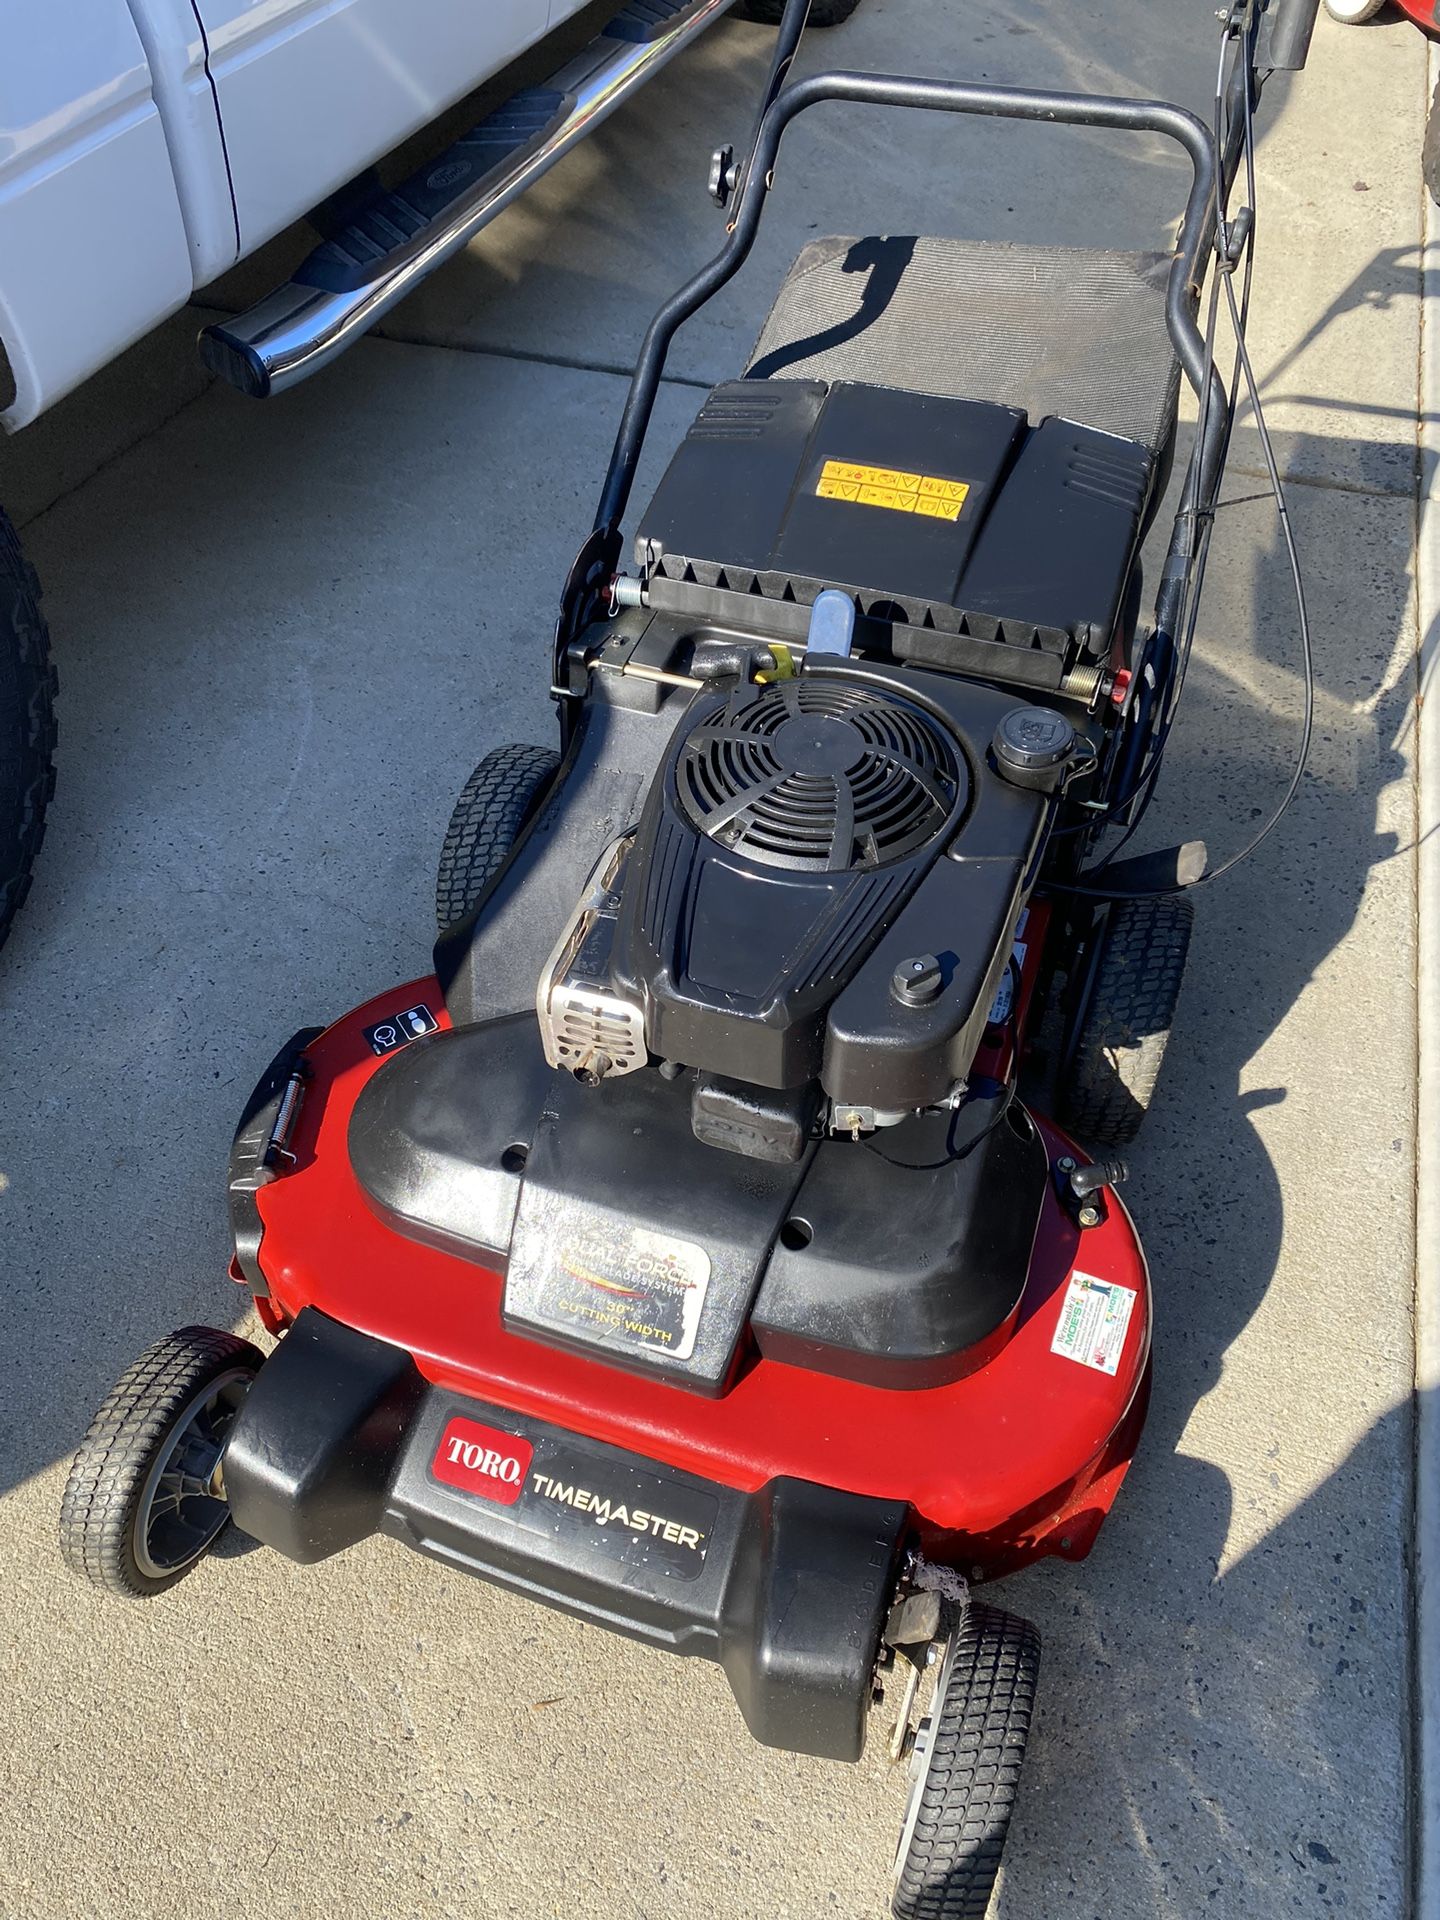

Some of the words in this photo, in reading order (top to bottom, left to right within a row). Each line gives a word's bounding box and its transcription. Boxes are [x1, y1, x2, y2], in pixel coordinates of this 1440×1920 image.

[624, 1254, 692, 1286] FORCE
[639, 1276, 684, 1297] SYSTEM
[558, 1299, 621, 1327] CUTTING
[624, 1320, 672, 1342] WIDTH
[1064, 1306, 1082, 1346] MOE'S
[448, 1437, 520, 1485] TORO
[532, 1472, 705, 1550] TIMEMASTER
